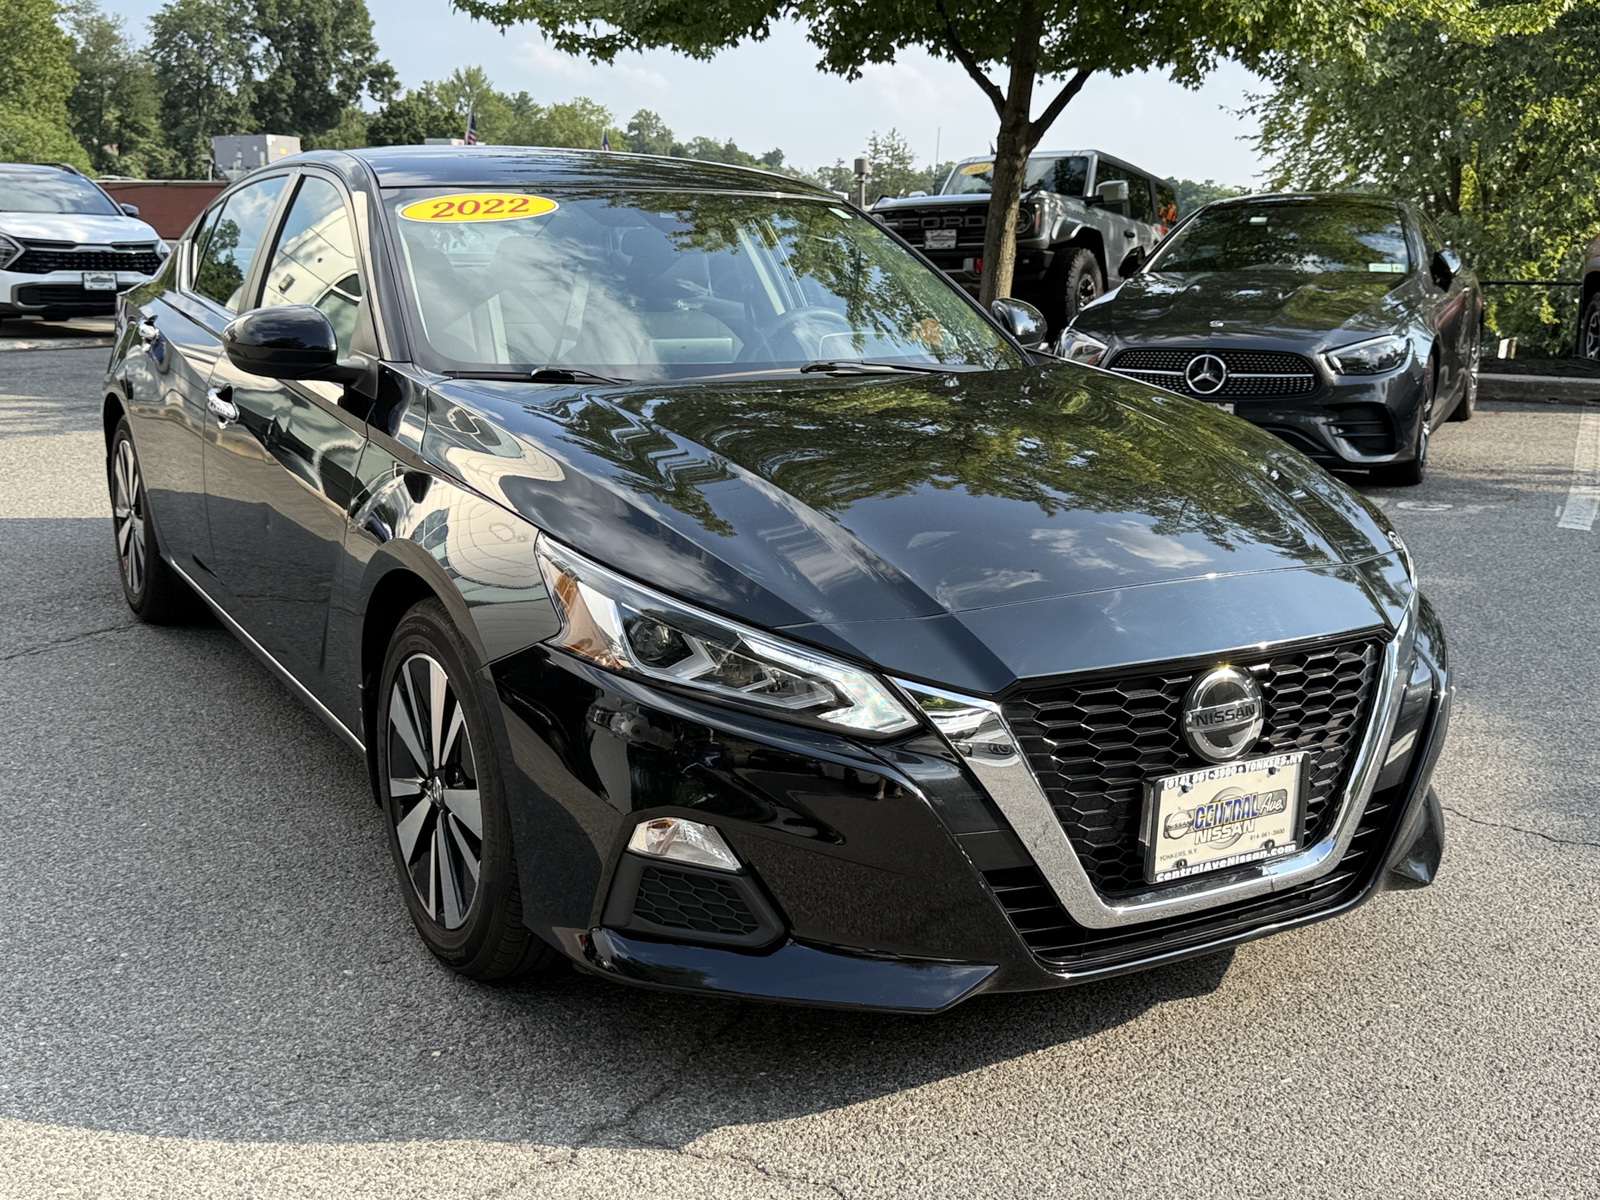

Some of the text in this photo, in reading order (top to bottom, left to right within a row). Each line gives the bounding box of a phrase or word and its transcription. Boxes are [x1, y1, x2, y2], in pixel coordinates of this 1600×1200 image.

[431, 198, 530, 219] 2022
[899, 215, 987, 230] FORD
[1195, 703, 1256, 727] NISSAN
[1193, 794, 1258, 830] CENTRAL
[1194, 818, 1256, 846] NISSAN
